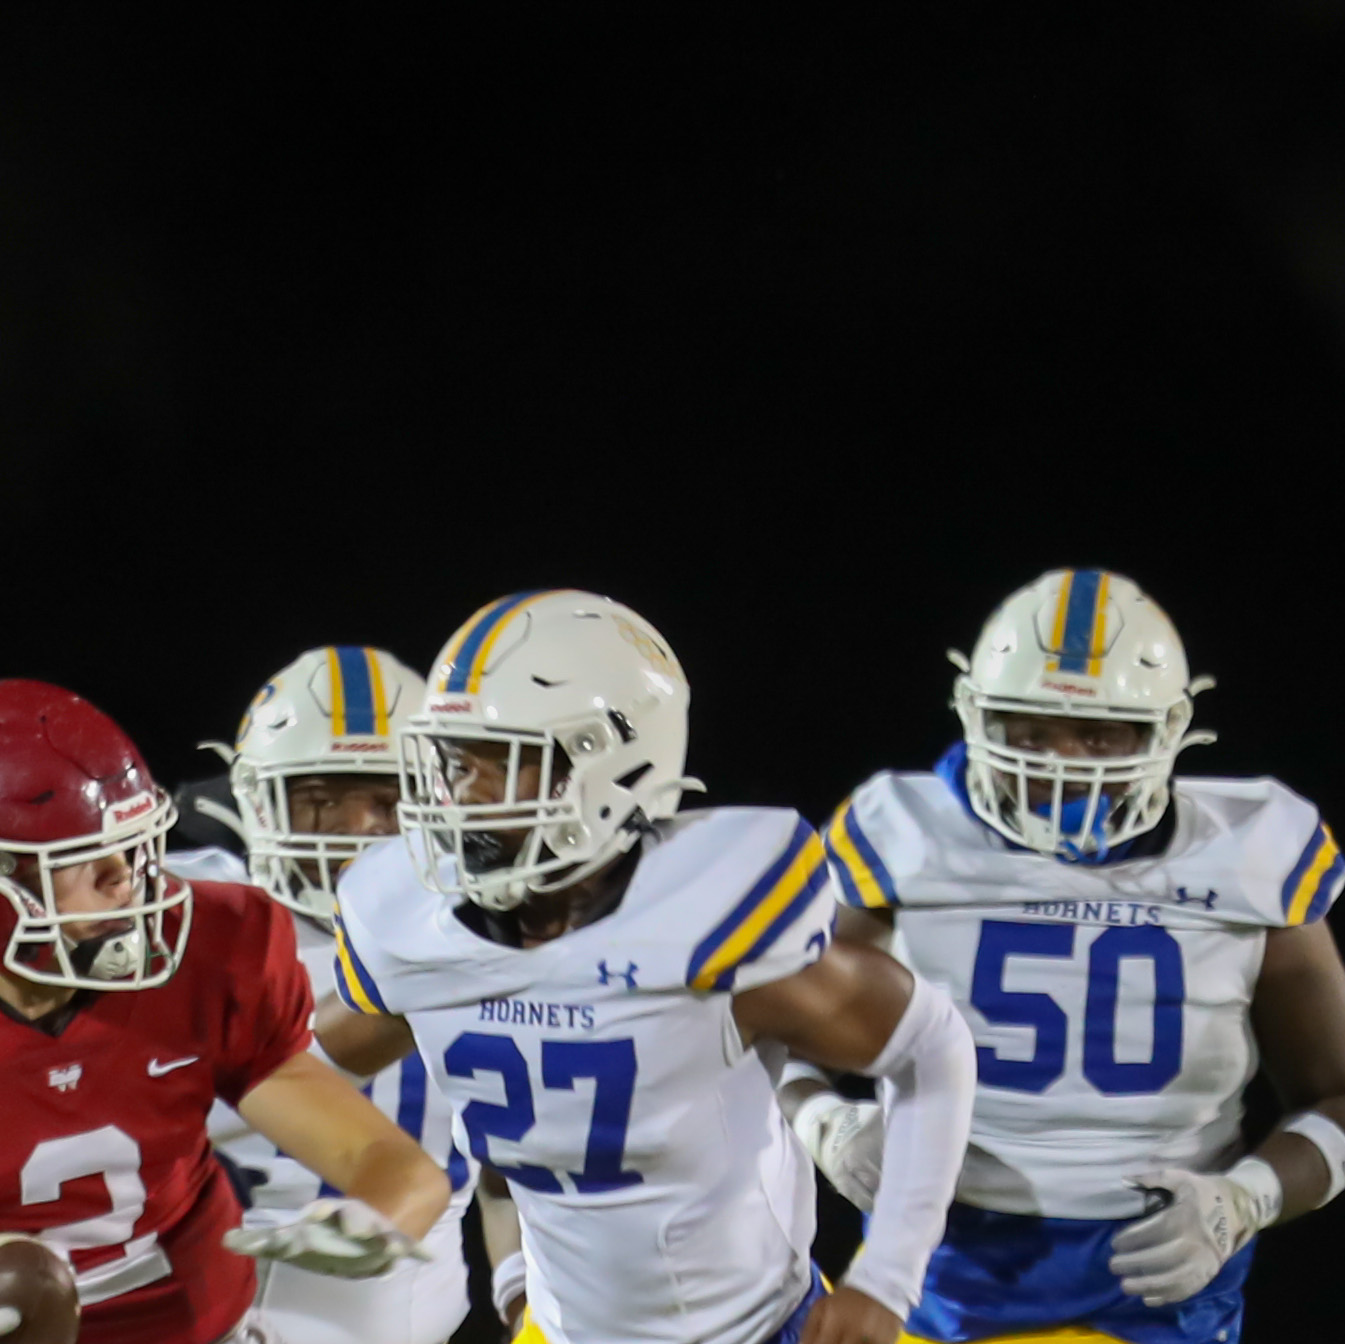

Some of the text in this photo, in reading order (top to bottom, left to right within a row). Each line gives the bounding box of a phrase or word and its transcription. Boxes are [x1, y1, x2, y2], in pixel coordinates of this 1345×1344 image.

[479, 998, 595, 1030] HORNETS
[970, 919, 1186, 1098] 50
[443, 1030, 645, 1195] 27
[20, 1122, 174, 1307] 2
